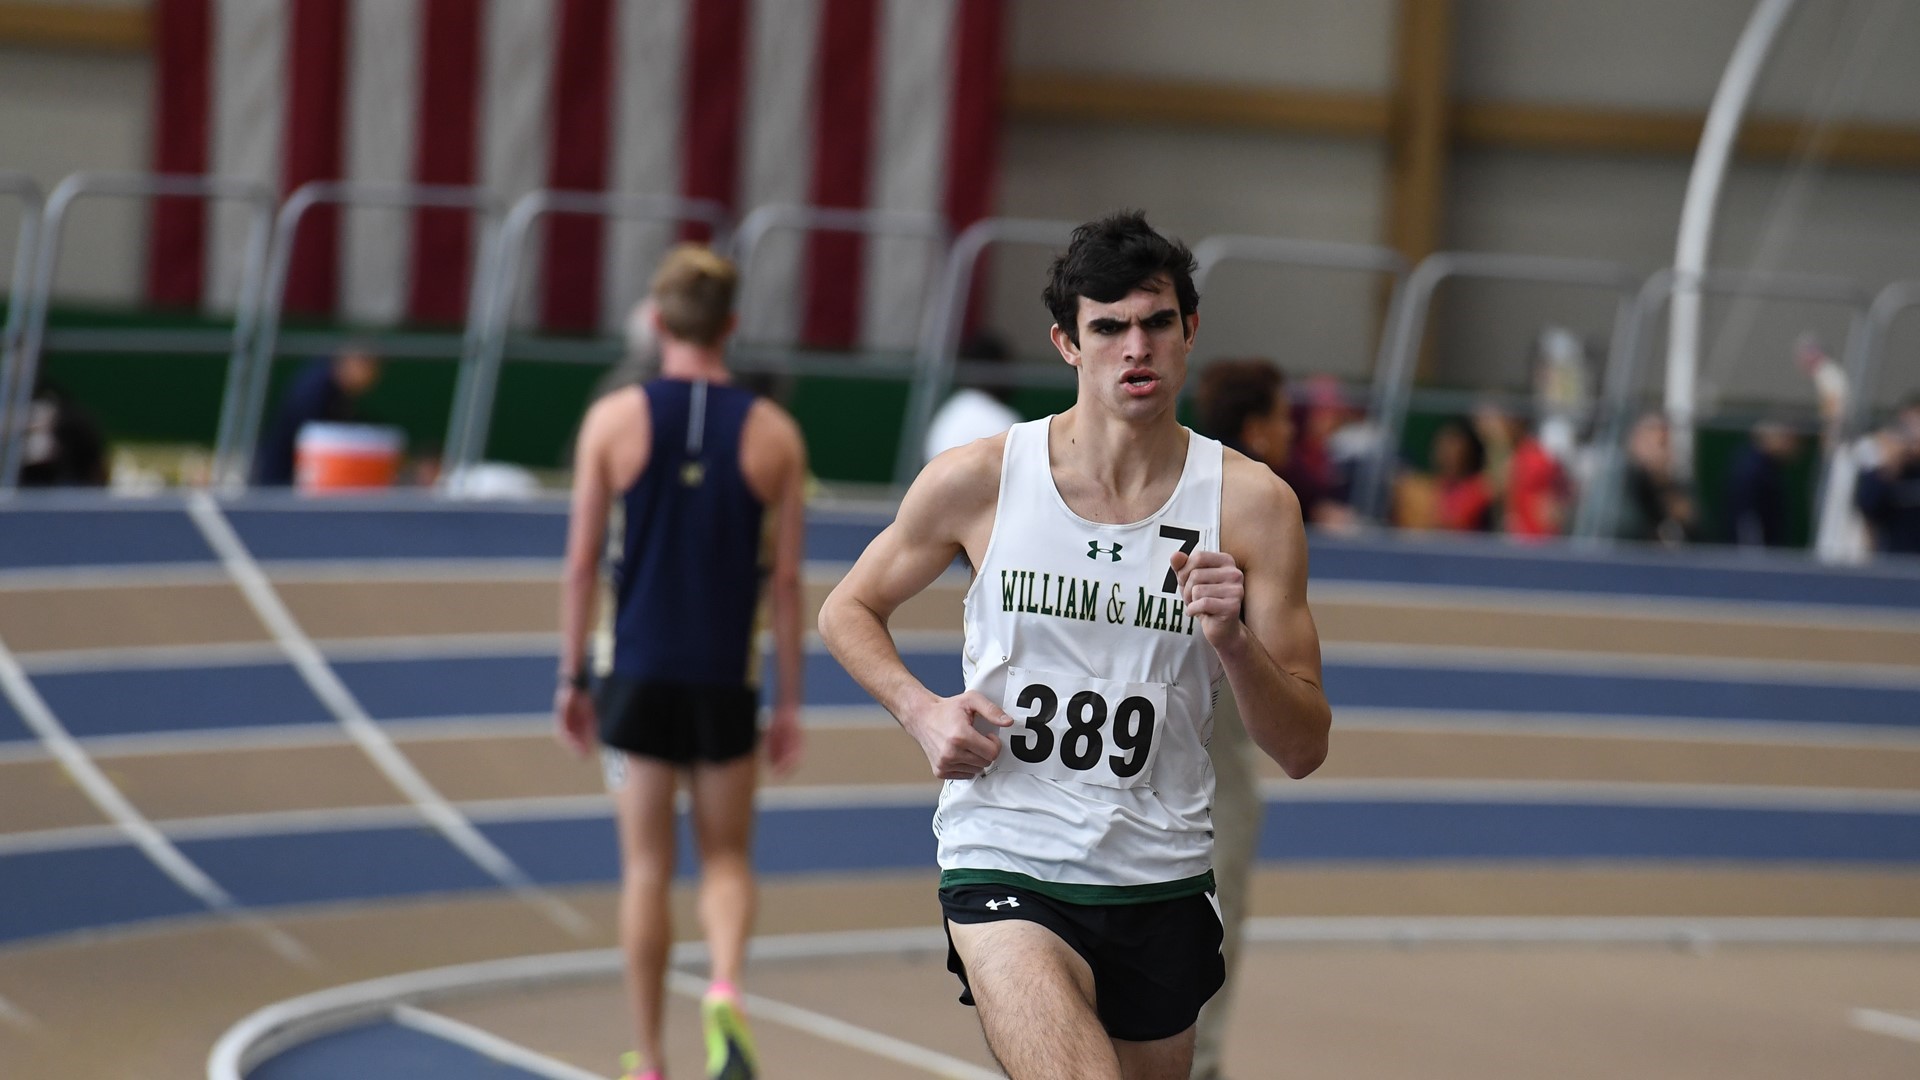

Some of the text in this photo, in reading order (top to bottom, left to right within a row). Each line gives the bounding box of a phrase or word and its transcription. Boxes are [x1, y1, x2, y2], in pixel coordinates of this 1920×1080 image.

[1159, 525, 1200, 594] 7
[1001, 570, 1099, 622] WILLIAM
[1106, 583, 1125, 624] &
[1010, 683, 1155, 778] 389
